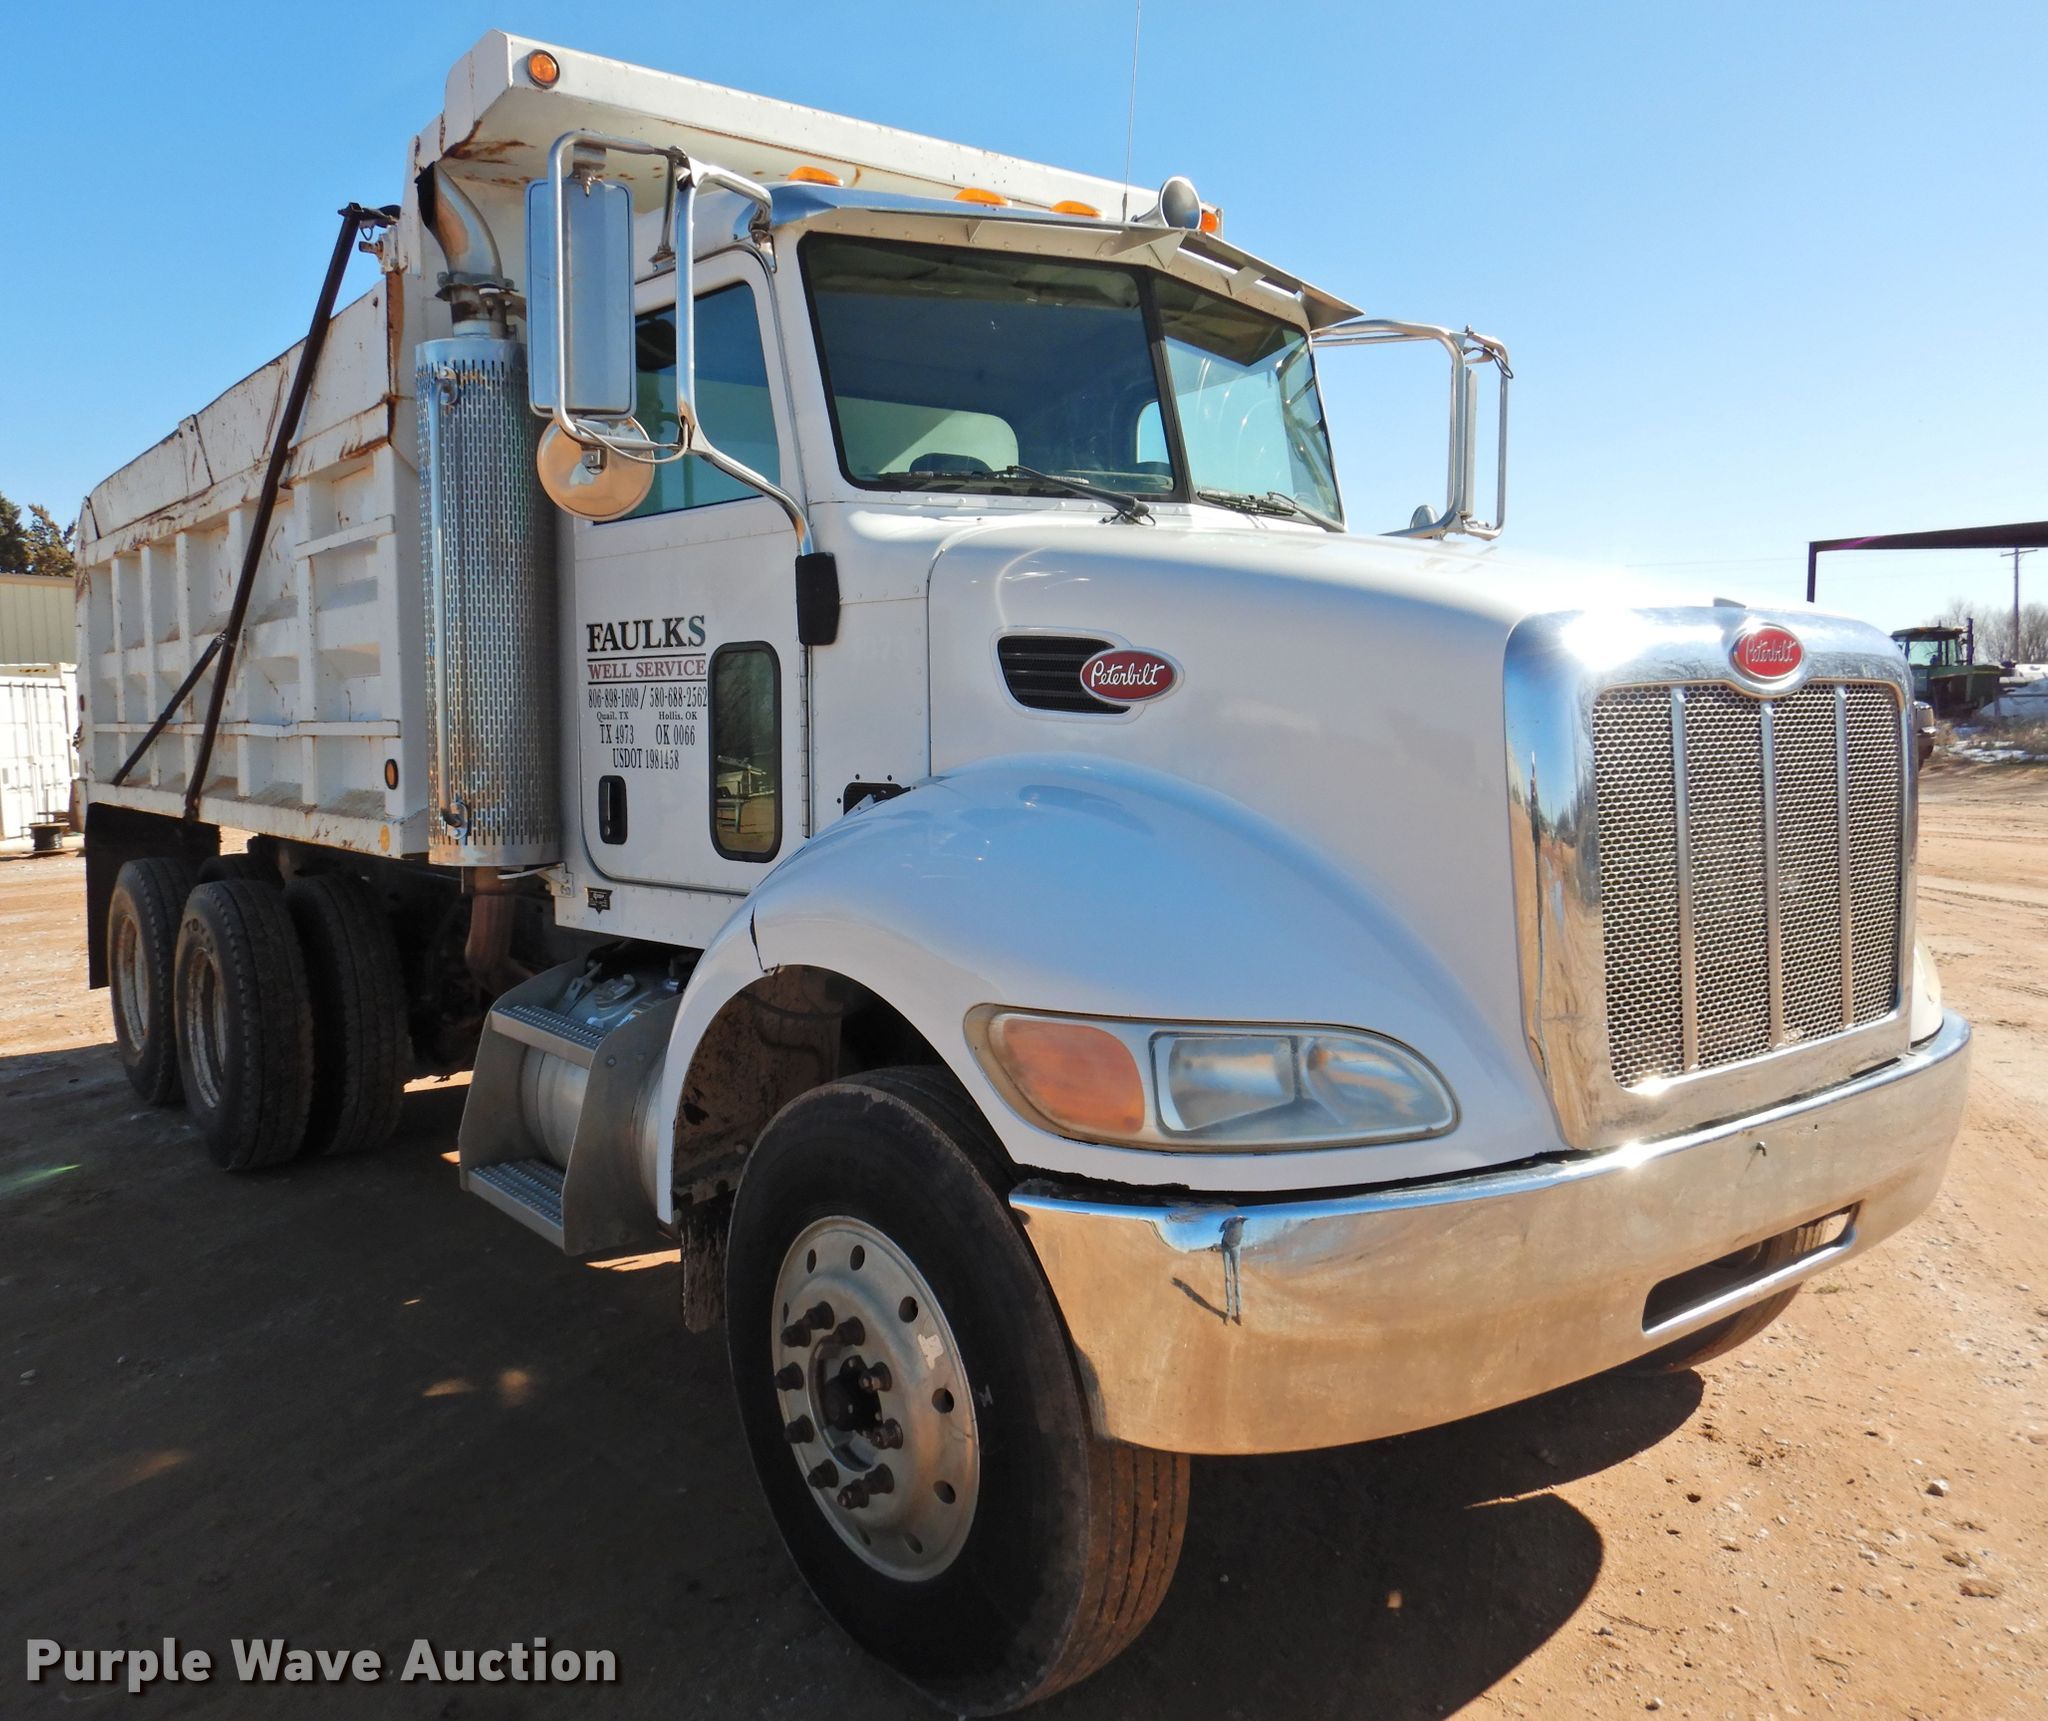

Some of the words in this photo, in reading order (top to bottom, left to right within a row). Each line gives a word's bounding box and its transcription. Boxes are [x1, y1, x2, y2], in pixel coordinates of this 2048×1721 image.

[586, 615, 706, 652] FAULKS
[1745, 633, 1796, 665] Peterbilt
[588, 663, 632, 680] WELL
[635, 659, 707, 678] SERVICE
[1090, 660, 1166, 687] Peterbilt
[619, 711, 629, 720] TX
[685, 711, 698, 720] OK
[600, 723, 613, 744] TX
[615, 724, 634, 745] 4973
[655, 723, 671, 745] OK
[673, 725, 696, 746] 0066
[612, 748, 643, 769] USDOT
